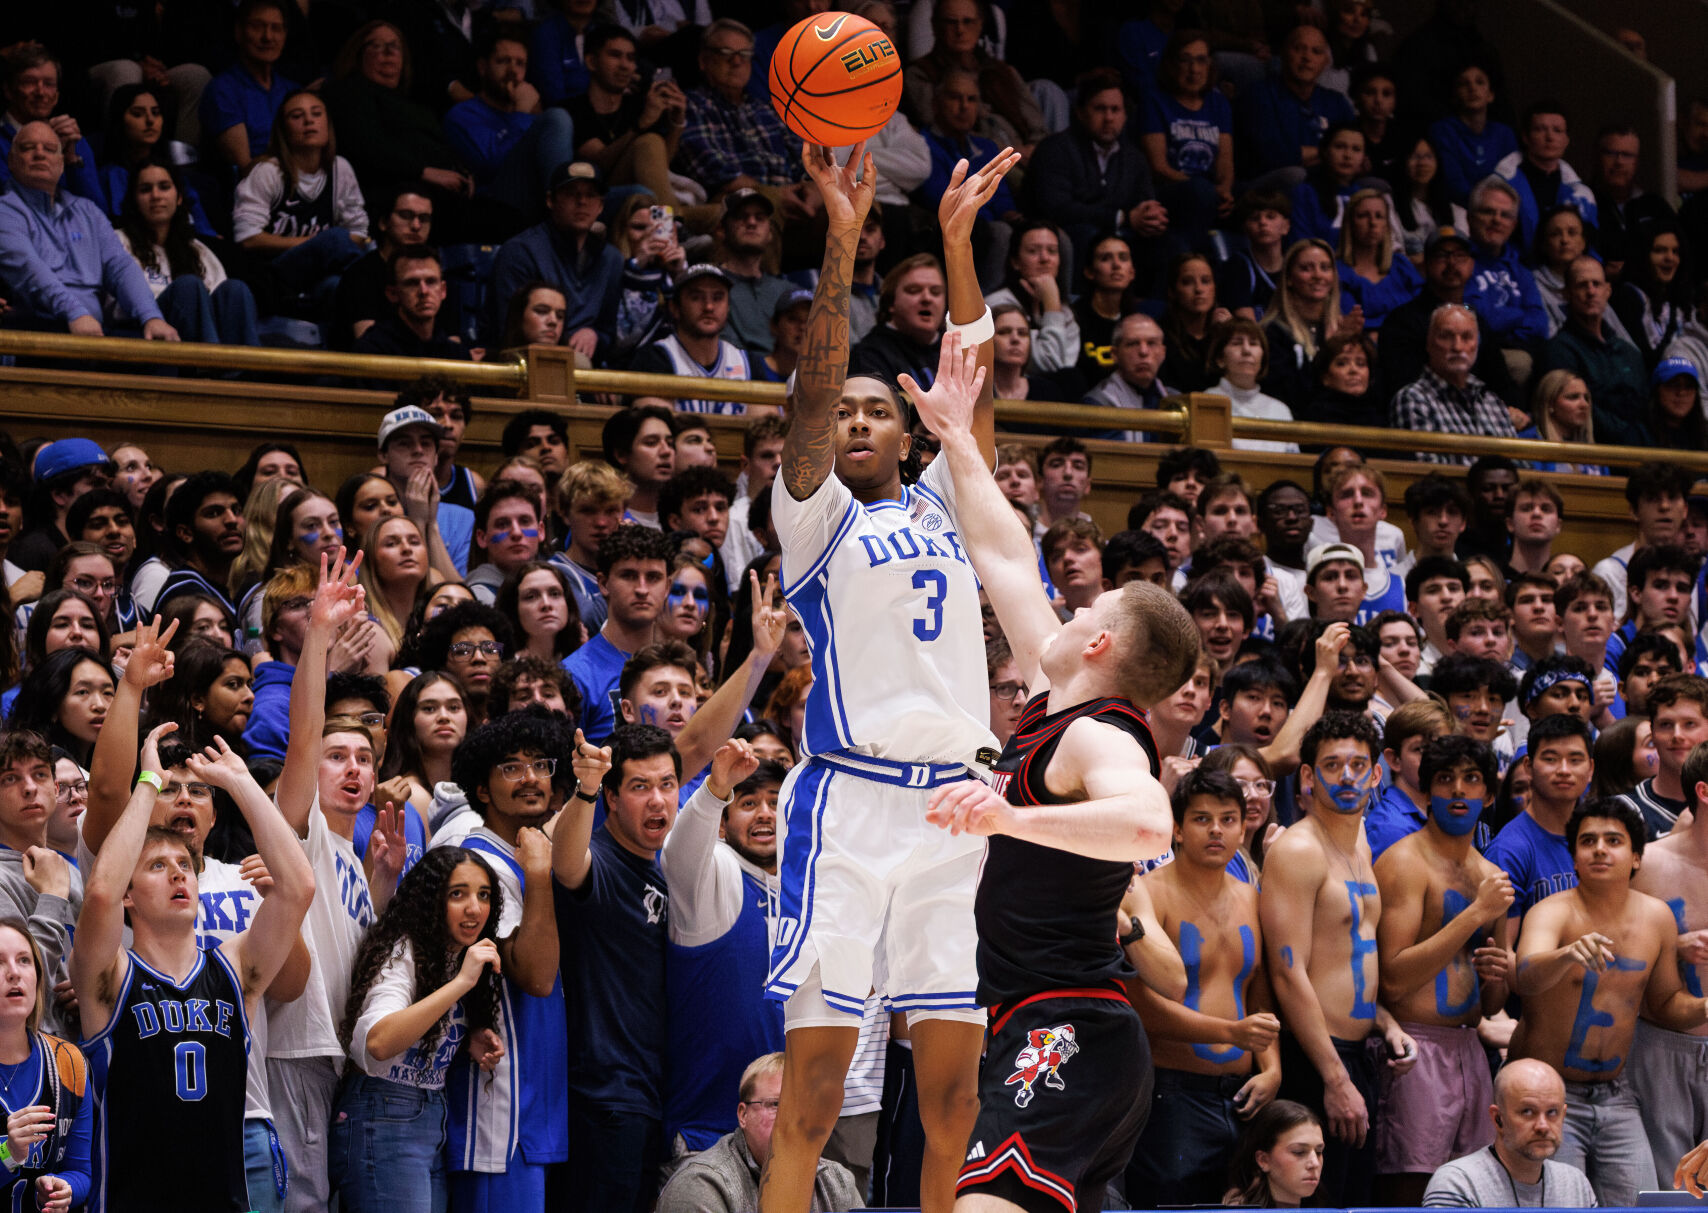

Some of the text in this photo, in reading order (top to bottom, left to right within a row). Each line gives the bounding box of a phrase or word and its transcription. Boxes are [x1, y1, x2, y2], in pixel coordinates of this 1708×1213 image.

[840, 39, 895, 74] ELITE
[858, 527, 968, 568] DUKE
[911, 570, 948, 642] 3
[776, 917, 799, 946] D
[131, 999, 234, 1040] DUKE
[174, 1041, 207, 1102] 0
